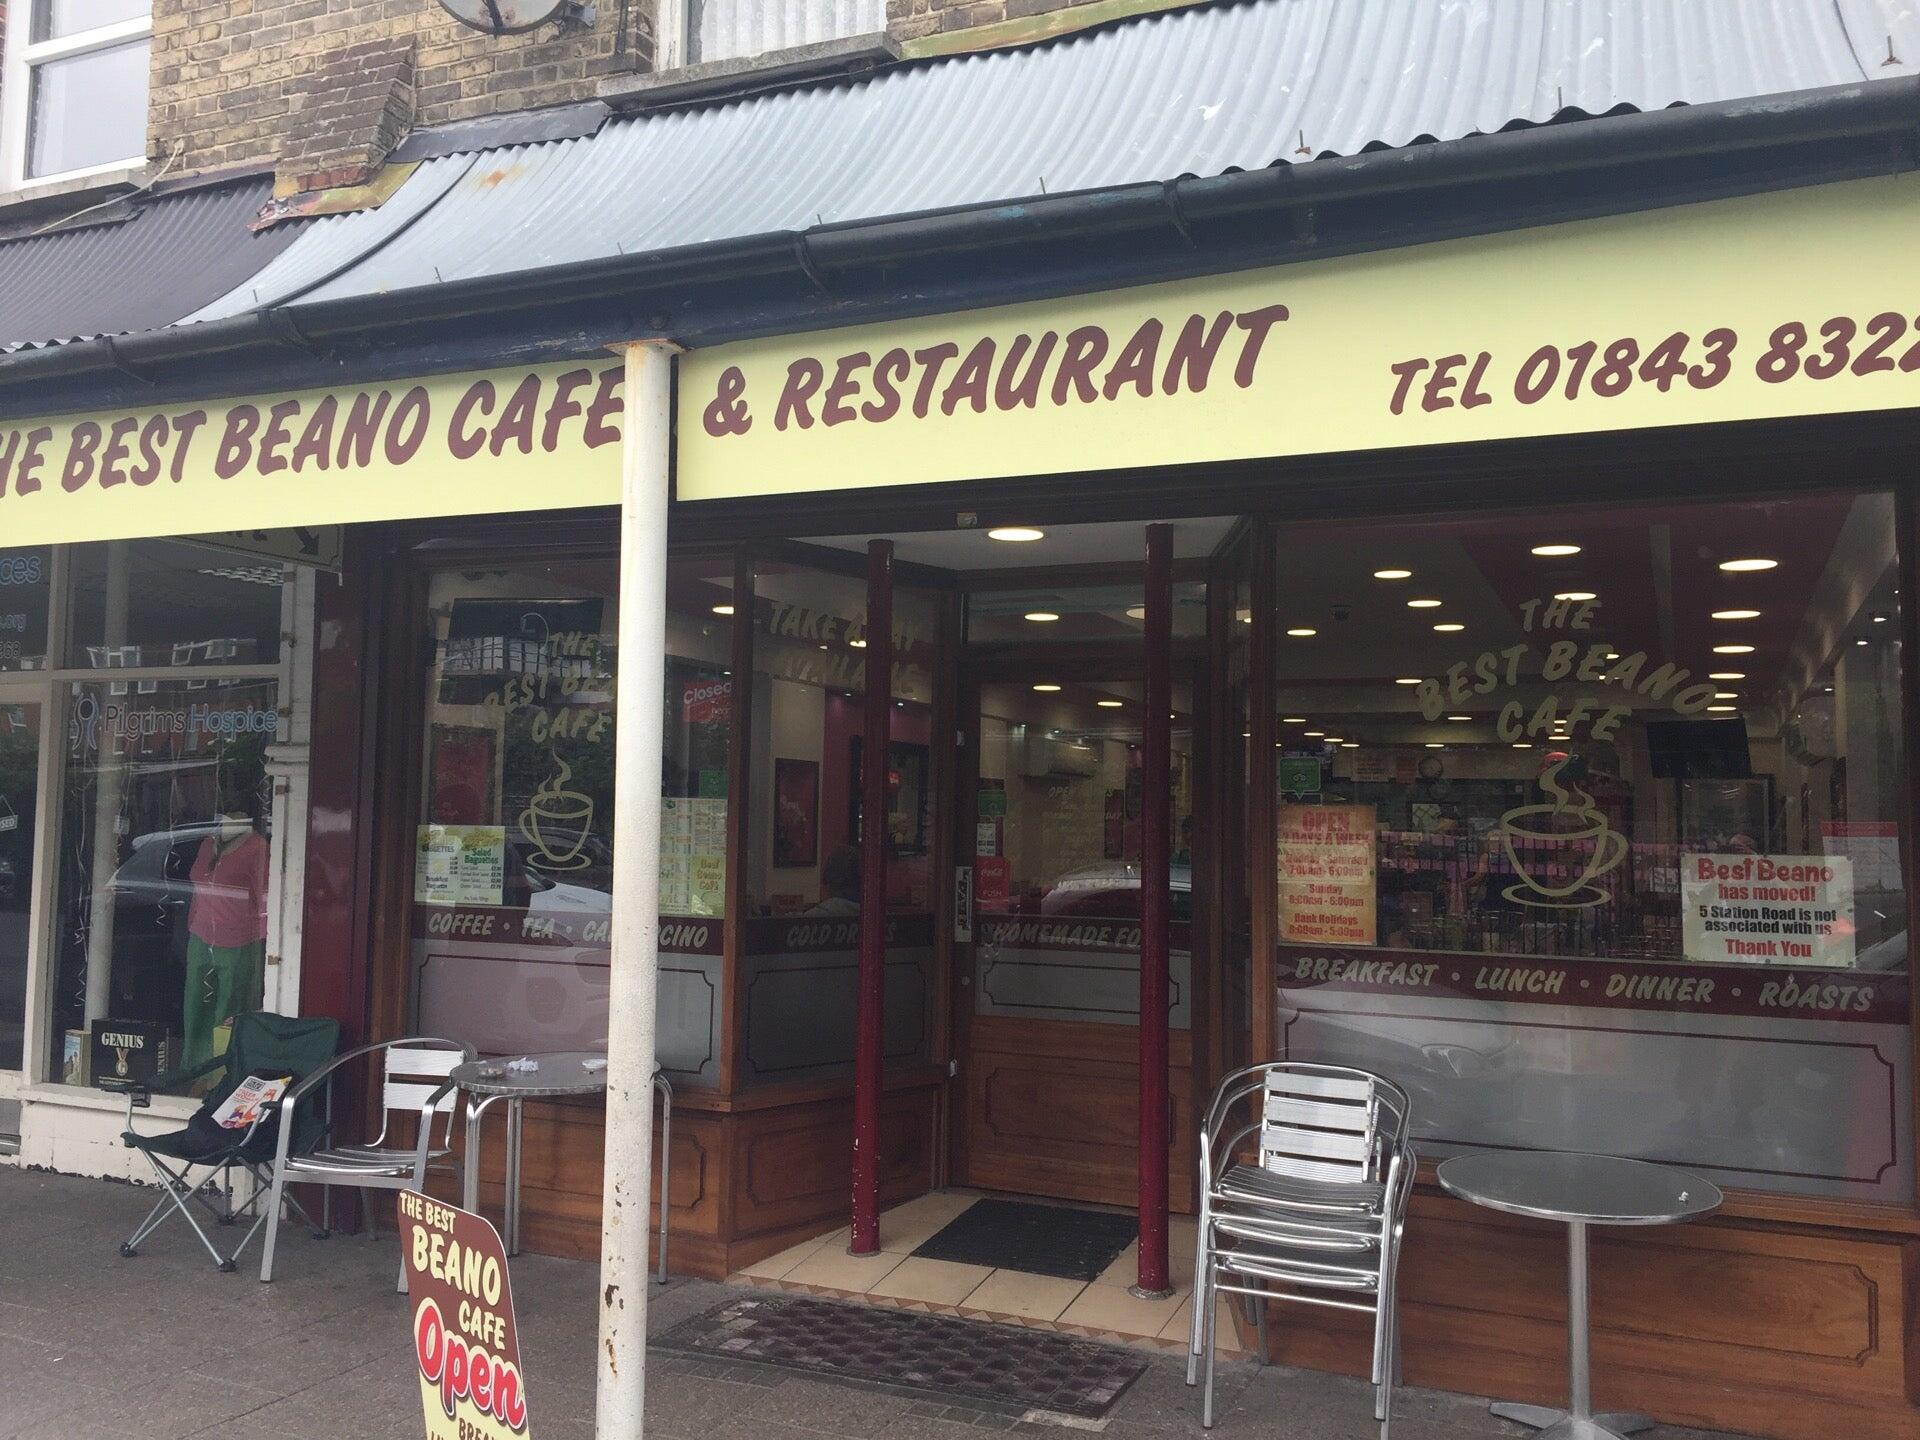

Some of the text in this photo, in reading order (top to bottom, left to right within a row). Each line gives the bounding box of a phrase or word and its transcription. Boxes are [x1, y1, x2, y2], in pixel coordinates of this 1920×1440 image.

[1390, 351, 1493, 416] TEL
[1514, 327, 1738, 405] 01843
[61, 409, 207, 494] BEST
[214, 384, 431, 480] BEANO
[447, 366, 625, 460] CAFE
[703, 366, 753, 438] &
[774, 304, 1290, 431] RESTAURANT
[770, 601, 837, 640] TAKE
[1519, 597, 1602, 633] THE
[549, 631, 599, 657] THE
[1416, 640, 1718, 722] BEST BEANO
[104, 703, 188, 742] Pilgrims
[531, 707, 612, 743] CAFE
[1497, 695, 1633, 743] CAFE
[1302, 811, 1350, 832] OPEN
[1698, 857, 1754, 881] Best
[1757, 859, 1834, 882] Beano
[1310, 884, 1343, 894] Sunday
[1718, 884, 1816, 902] has moved!
[428, 912, 496, 937] COFFEE
[521, 917, 556, 938] TEA
[1294, 913, 1359, 926] Bank Holidays
[1700, 905, 1837, 922] 5 Station Road is not
[1704, 919, 1832, 935] associated with us
[787, 923, 832, 947] COLD
[992, 922, 1112, 946] HOMEMADE
[1725, 938, 1812, 957] Thank You
[1295, 957, 1874, 1012] BREAKFAST LUNCH DINNER ROASTS
[101, 1032, 144, 1049] GENIUS
[400, 1192, 457, 1235] THE BEST
[412, 1225, 501, 1307] BEANO
[458, 1300, 506, 1350] CAFE
[414, 1297, 526, 1429] Open
